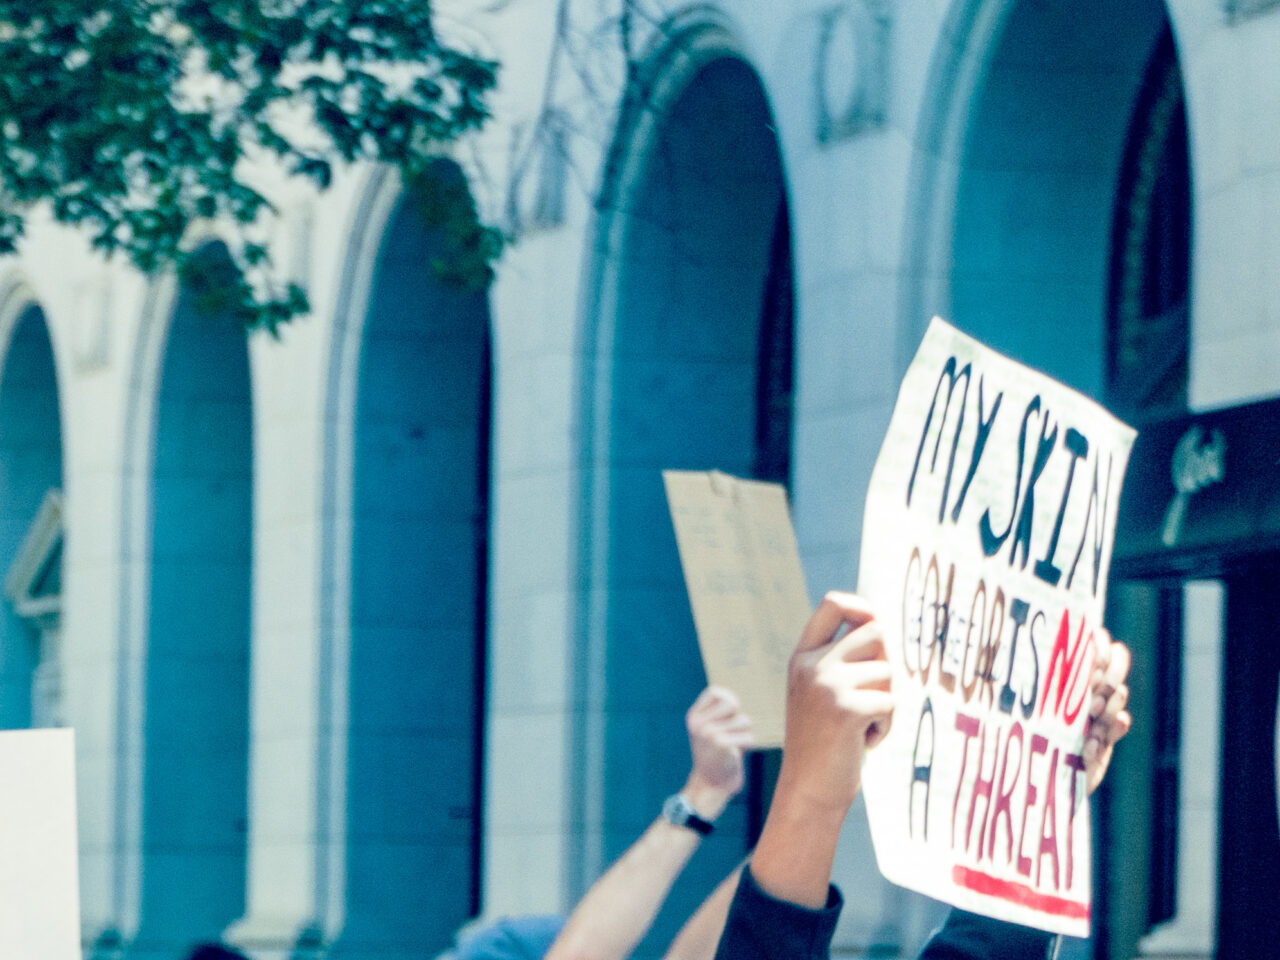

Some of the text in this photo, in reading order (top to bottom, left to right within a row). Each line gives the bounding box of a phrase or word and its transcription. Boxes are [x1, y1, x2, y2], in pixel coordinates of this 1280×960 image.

[906, 356, 1113, 598] MY SKIN
[903, 545, 1005, 712] COLOR
[998, 597, 1047, 721] IS
[909, 695, 1086, 892] A THREAT
